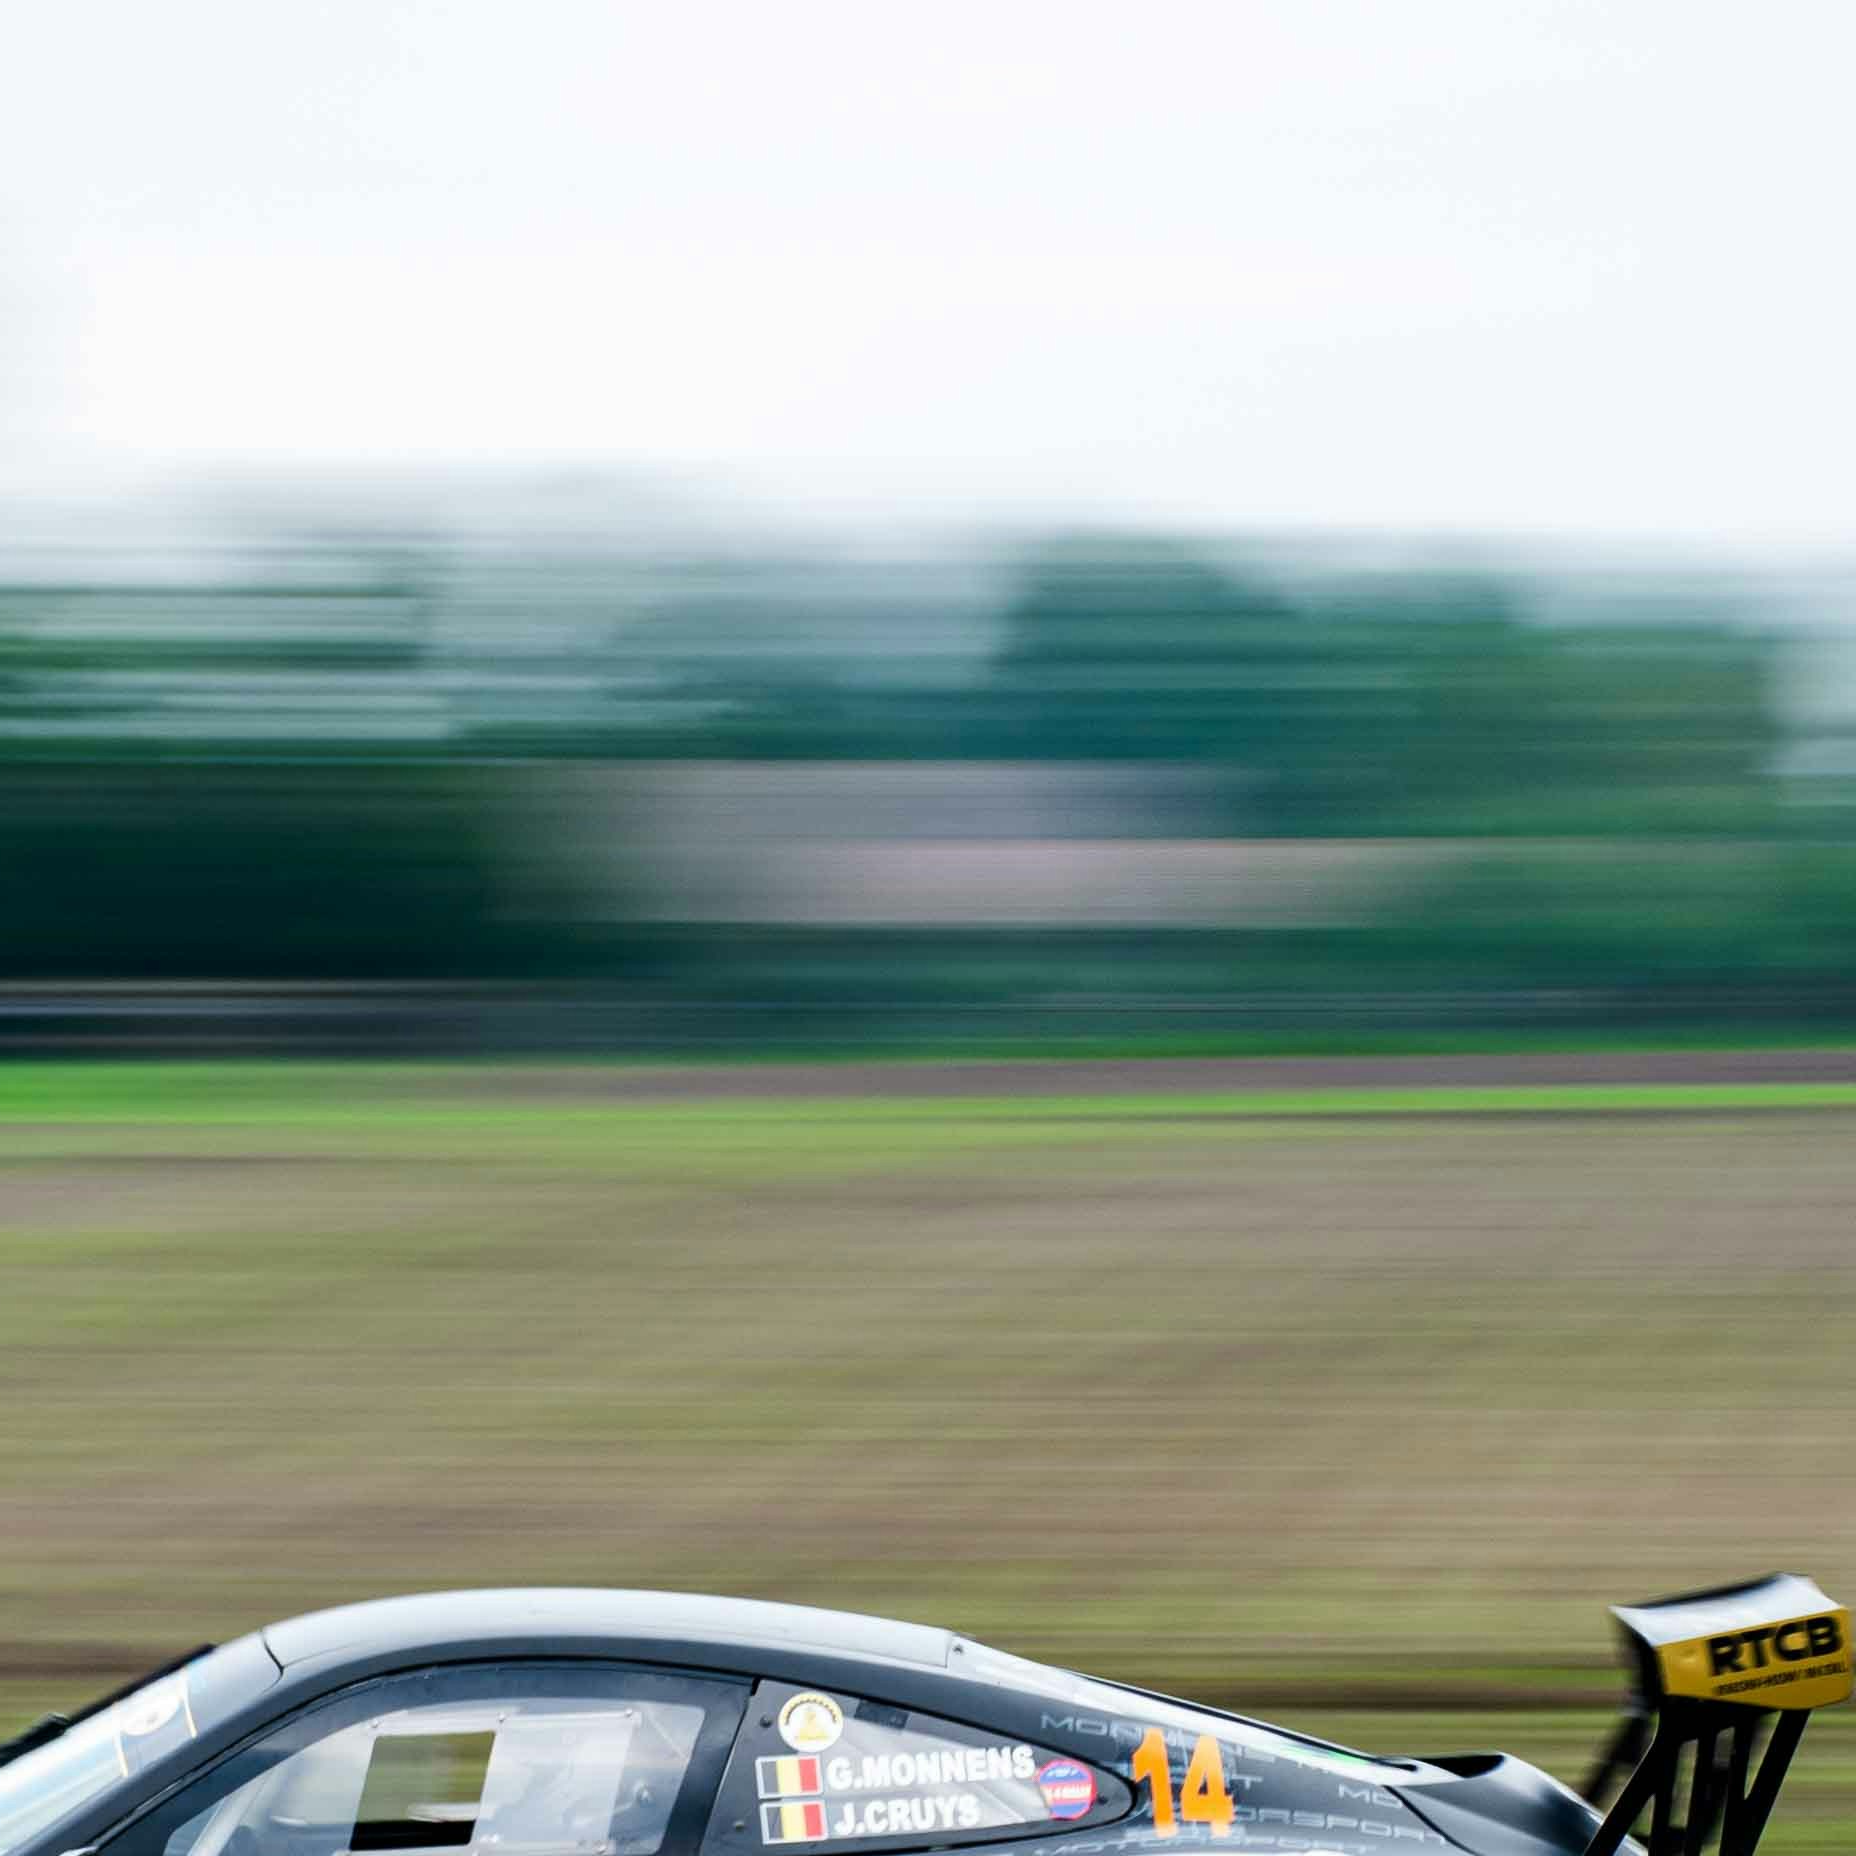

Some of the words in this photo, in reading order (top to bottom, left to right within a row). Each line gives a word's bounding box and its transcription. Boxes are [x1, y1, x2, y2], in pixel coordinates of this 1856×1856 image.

[1707, 1615, 1842, 1677] RTCB
[825, 1744, 1037, 1790] G.MONNENS
[1131, 1727, 1235, 1839] 14
[832, 1794, 981, 1836] J.CRUYS
